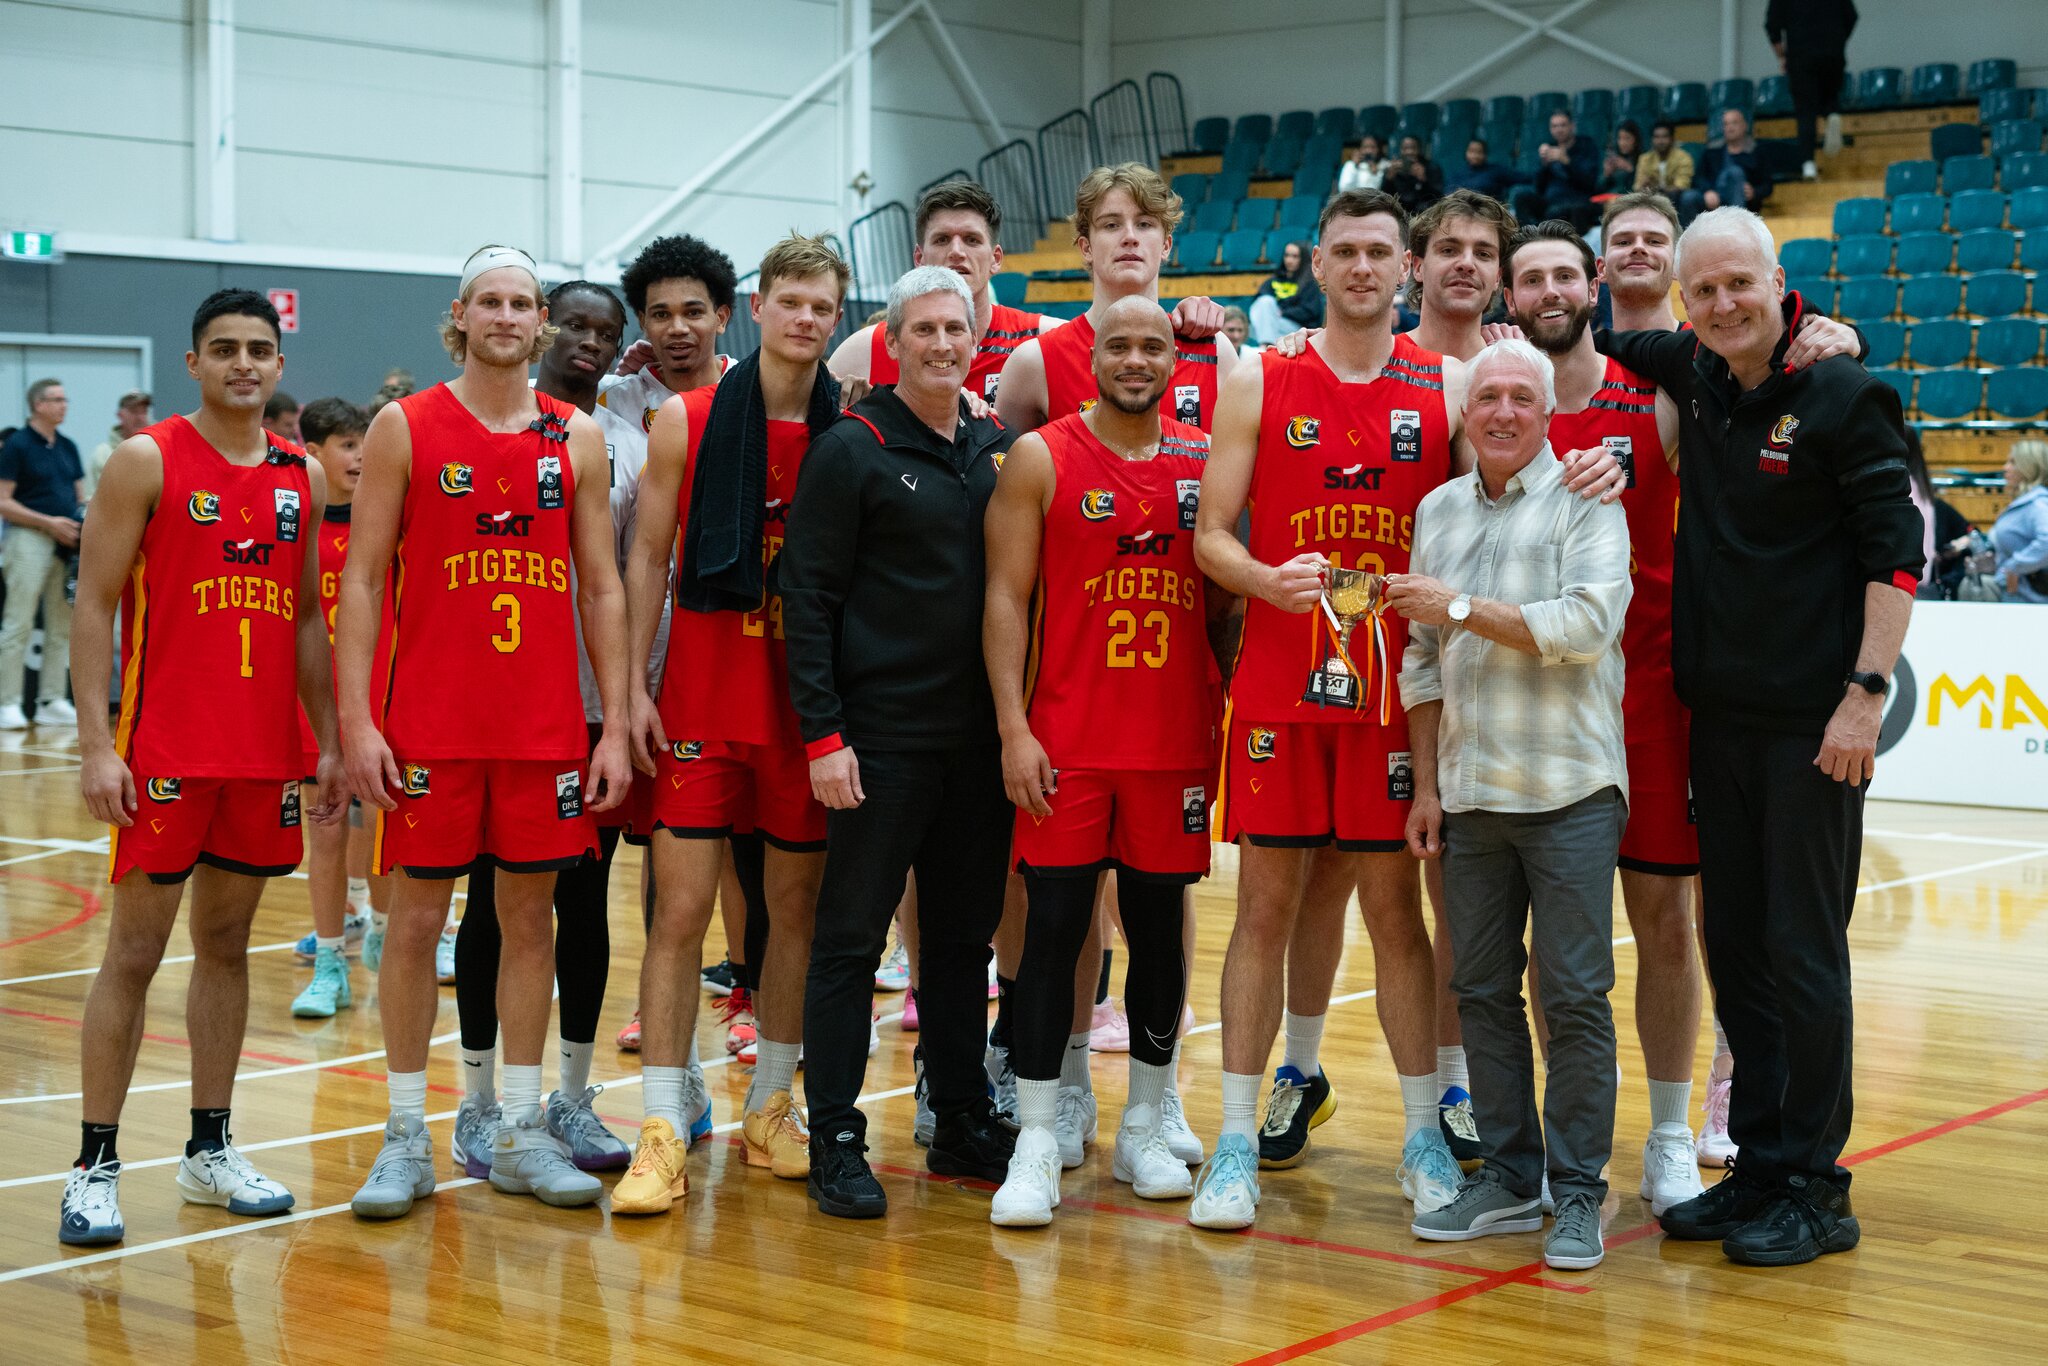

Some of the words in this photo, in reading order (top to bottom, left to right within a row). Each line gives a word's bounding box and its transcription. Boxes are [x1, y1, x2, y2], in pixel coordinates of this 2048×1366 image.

[1400, 428, 1412, 436] NBL
[1396, 442, 1417, 452] ONE
[1760, 448, 1790, 462] MELBOURNE
[1759, 457, 1789, 475] TIGERS
[543, 489, 560, 499] ONE
[1183, 511, 1197, 520] ON
[281, 521, 297, 533] ONE
[1289, 503, 1413, 553] TIGERS
[443, 548, 567, 593] TIGERS
[1084, 567, 1196, 611] TIGERS
[192, 575, 294, 622] TIGERS
[491, 593, 521, 653] 3
[1106, 609, 1170, 669] 23
[239, 617, 254, 678] 1
[1318, 674, 1345, 689] IXT
[2024, 738, 2048, 755] D
[1393, 782, 1411, 792] ONE
[562, 799, 579, 811] ONE
[1188, 815, 1204, 825] ONE
